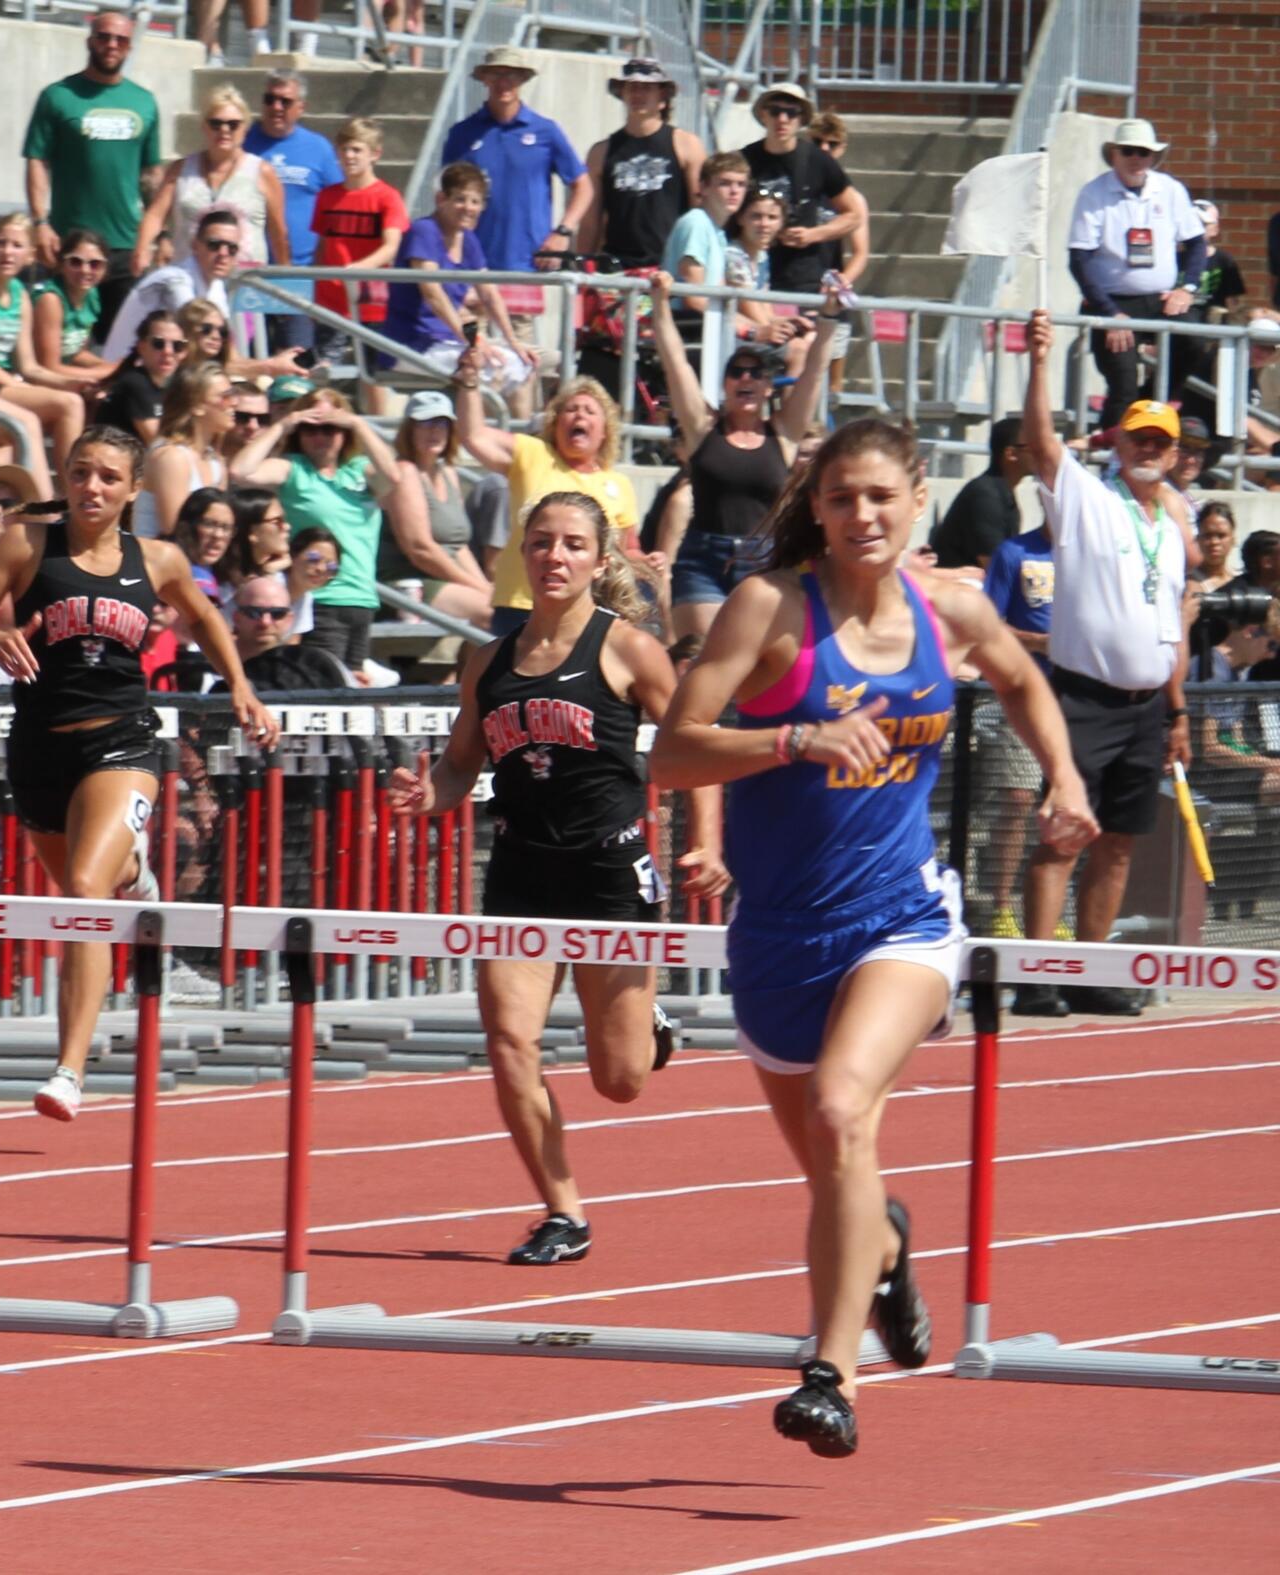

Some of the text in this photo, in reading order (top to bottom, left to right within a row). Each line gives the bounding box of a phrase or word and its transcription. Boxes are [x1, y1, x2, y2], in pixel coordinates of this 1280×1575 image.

[44, 596, 149, 652] COAL GROVE
[482, 698, 599, 764] COAL GROVE
[875, 711, 950, 747] RION
[51, 916, 114, 932] UCS
[334, 923, 687, 964] UCS OHIO STATE
[1020, 958, 1086, 975] UCS
[1131, 952, 1239, 989] OHIO
[1201, 1356, 1279, 1374] UCS
